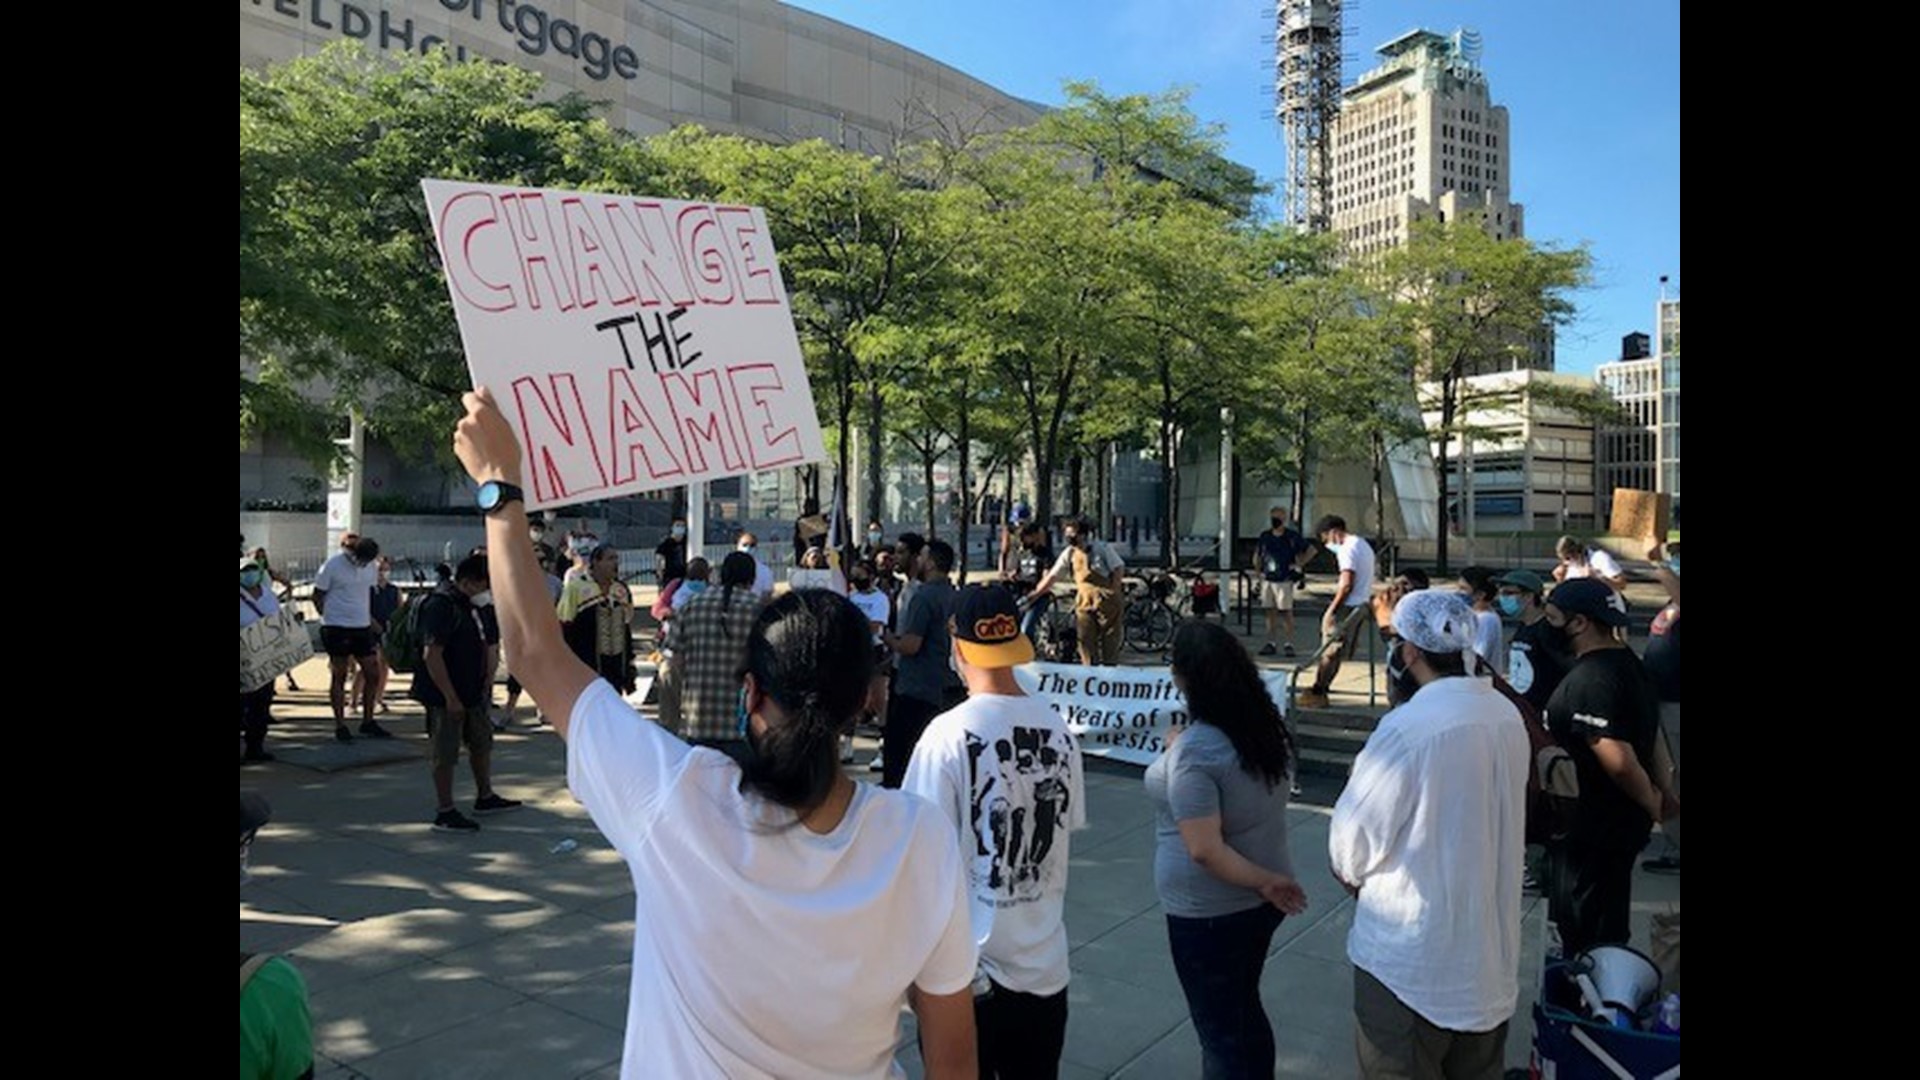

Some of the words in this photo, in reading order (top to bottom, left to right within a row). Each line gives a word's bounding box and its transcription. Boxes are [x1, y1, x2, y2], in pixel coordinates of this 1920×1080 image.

[440, 191, 781, 312] CHANGE
[595, 307, 702, 373] THE
[511, 363, 803, 502] NAME
[1038, 672, 1078, 695] The
[1067, 704, 1126, 730] Years
[1132, 707, 1160, 730] of
